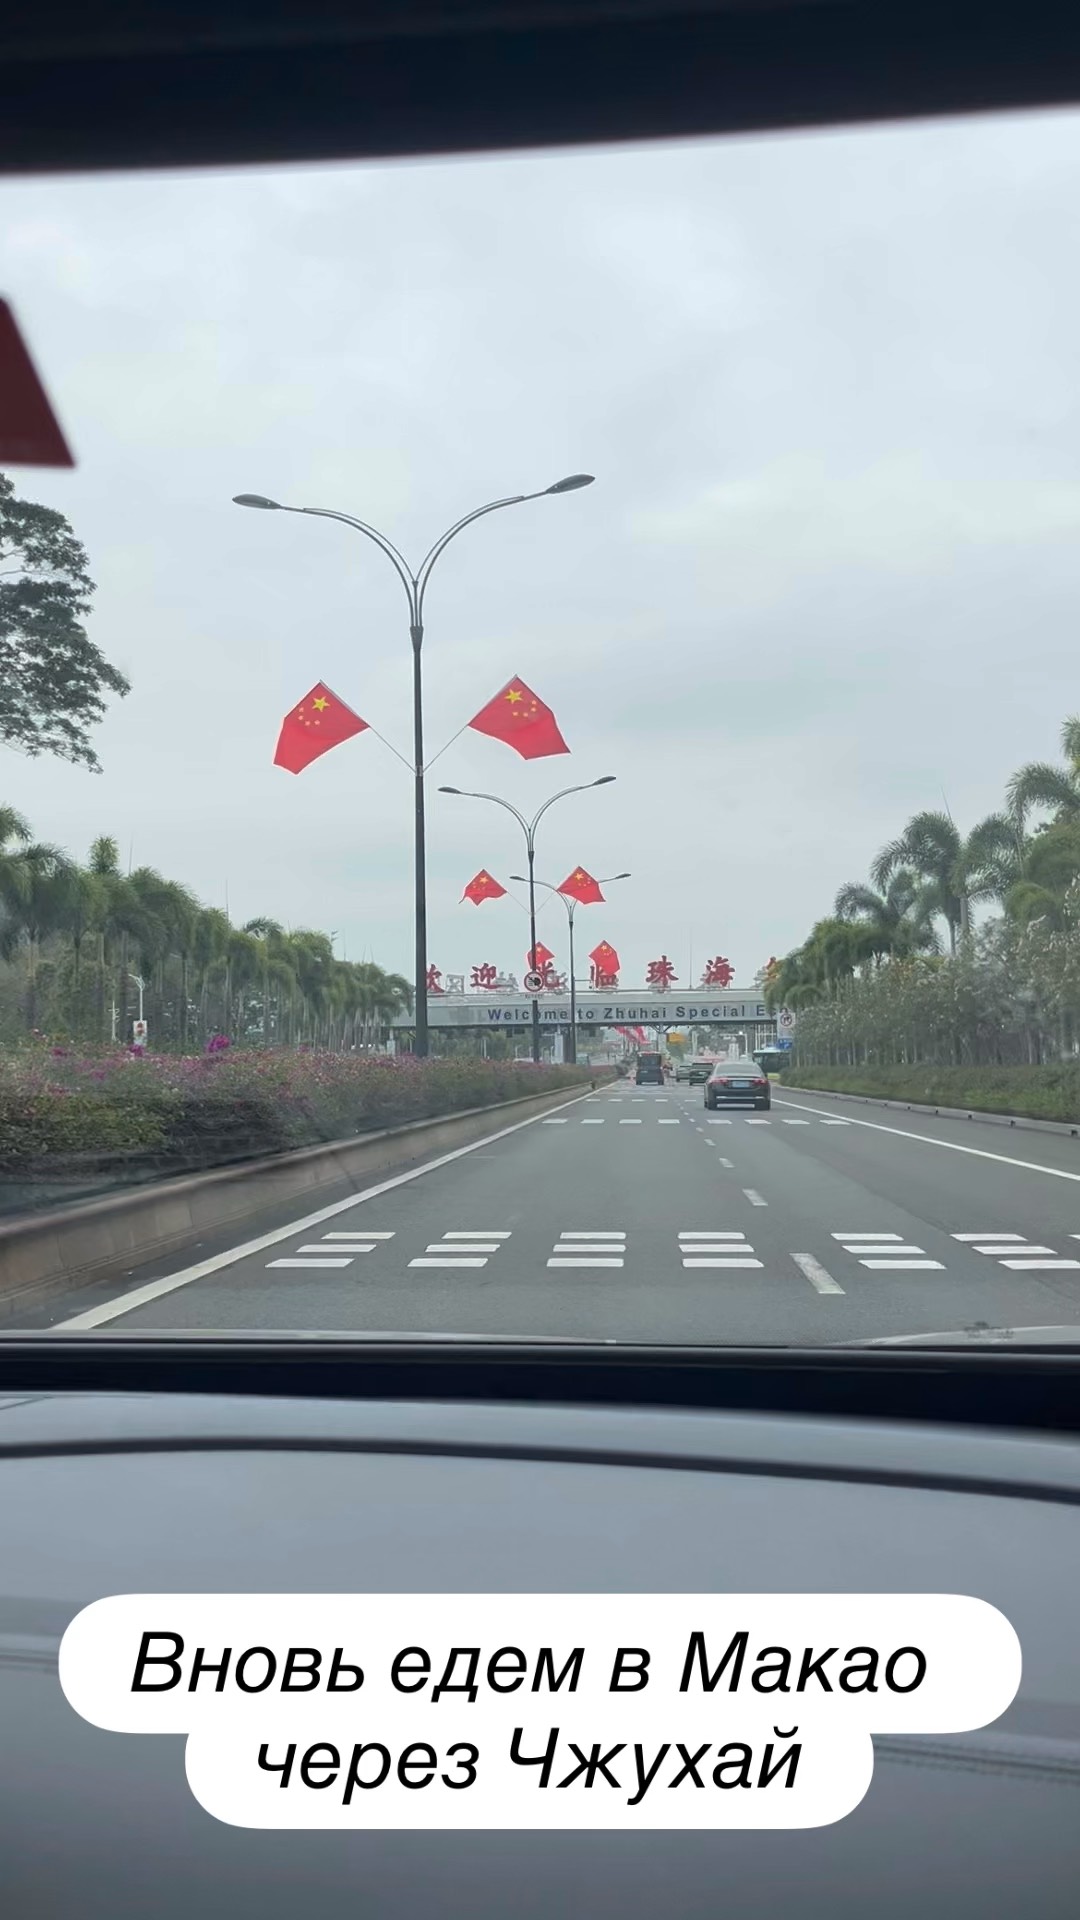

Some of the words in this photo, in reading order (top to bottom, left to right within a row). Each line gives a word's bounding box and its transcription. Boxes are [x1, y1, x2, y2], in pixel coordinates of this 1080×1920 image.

[577, 1009, 594, 1020] to
[603, 1007, 666, 1019] Zhuhai
[675, 1004, 745, 1020] Special
